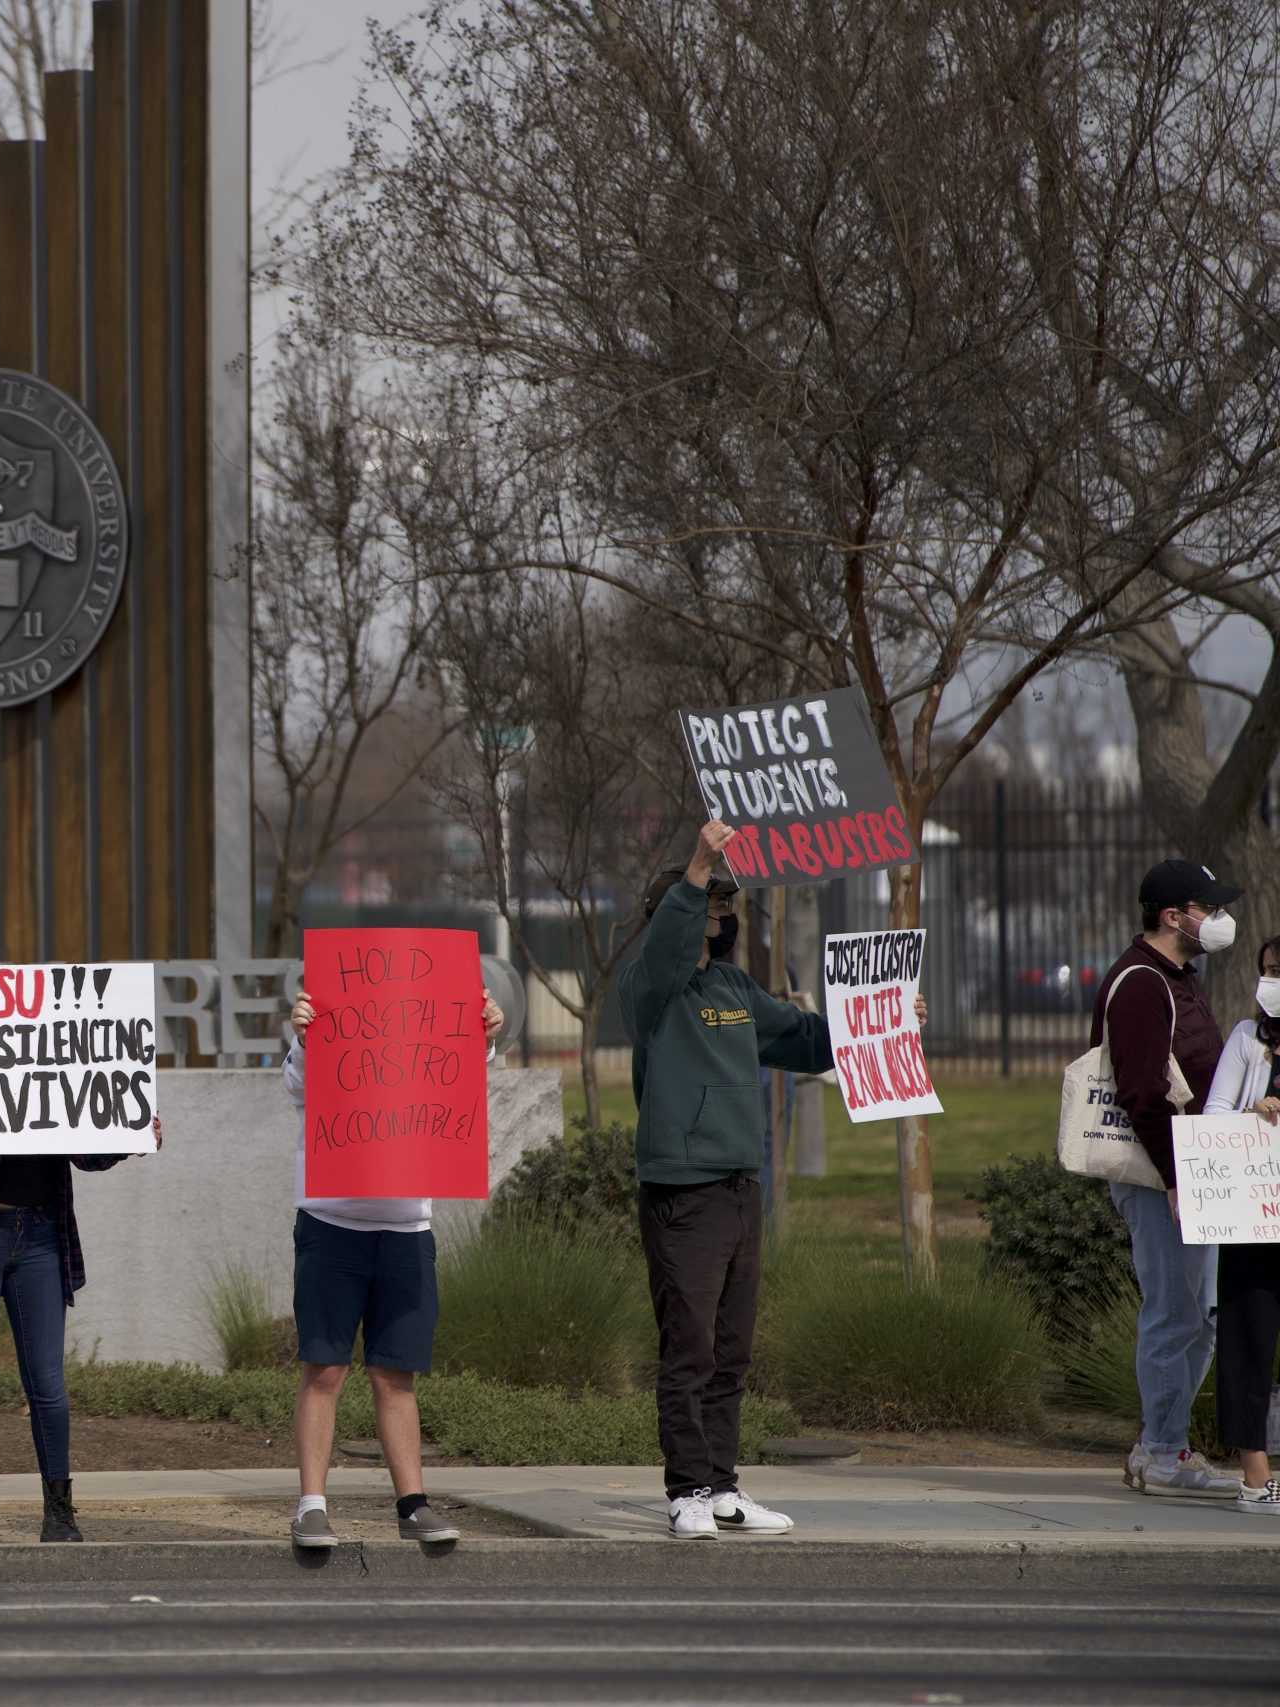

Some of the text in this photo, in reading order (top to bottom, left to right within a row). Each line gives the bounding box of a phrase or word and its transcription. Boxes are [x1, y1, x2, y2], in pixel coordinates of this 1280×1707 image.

[54, 406, 121, 626] UNIVERSITY
[23, 611, 44, 637] 11
[688, 699, 833, 766] PROTECT
[700, 757, 848, 819] STUDENTS,
[723, 805, 913, 878] NOT ABUSERS
[338, 947, 433, 992] HOLD
[826, 935, 872, 987] JOSEPH
[880, 931, 923, 982] CASTRO
[319, 999, 470, 1044] JOSEPH I
[845, 985, 903, 1039] UPLIFTS
[336, 1041, 461, 1092] CASTRO
[836, 1041, 893, 1110] SEXUAL
[314, 1096, 480, 1154] ACCOUNTABLE!
[1182, 1115, 1271, 1161] Joseph
[1181, 1157, 1232, 1181] Take
[1191, 1185, 1240, 1212] your
[1197, 1224, 1238, 1243] your
